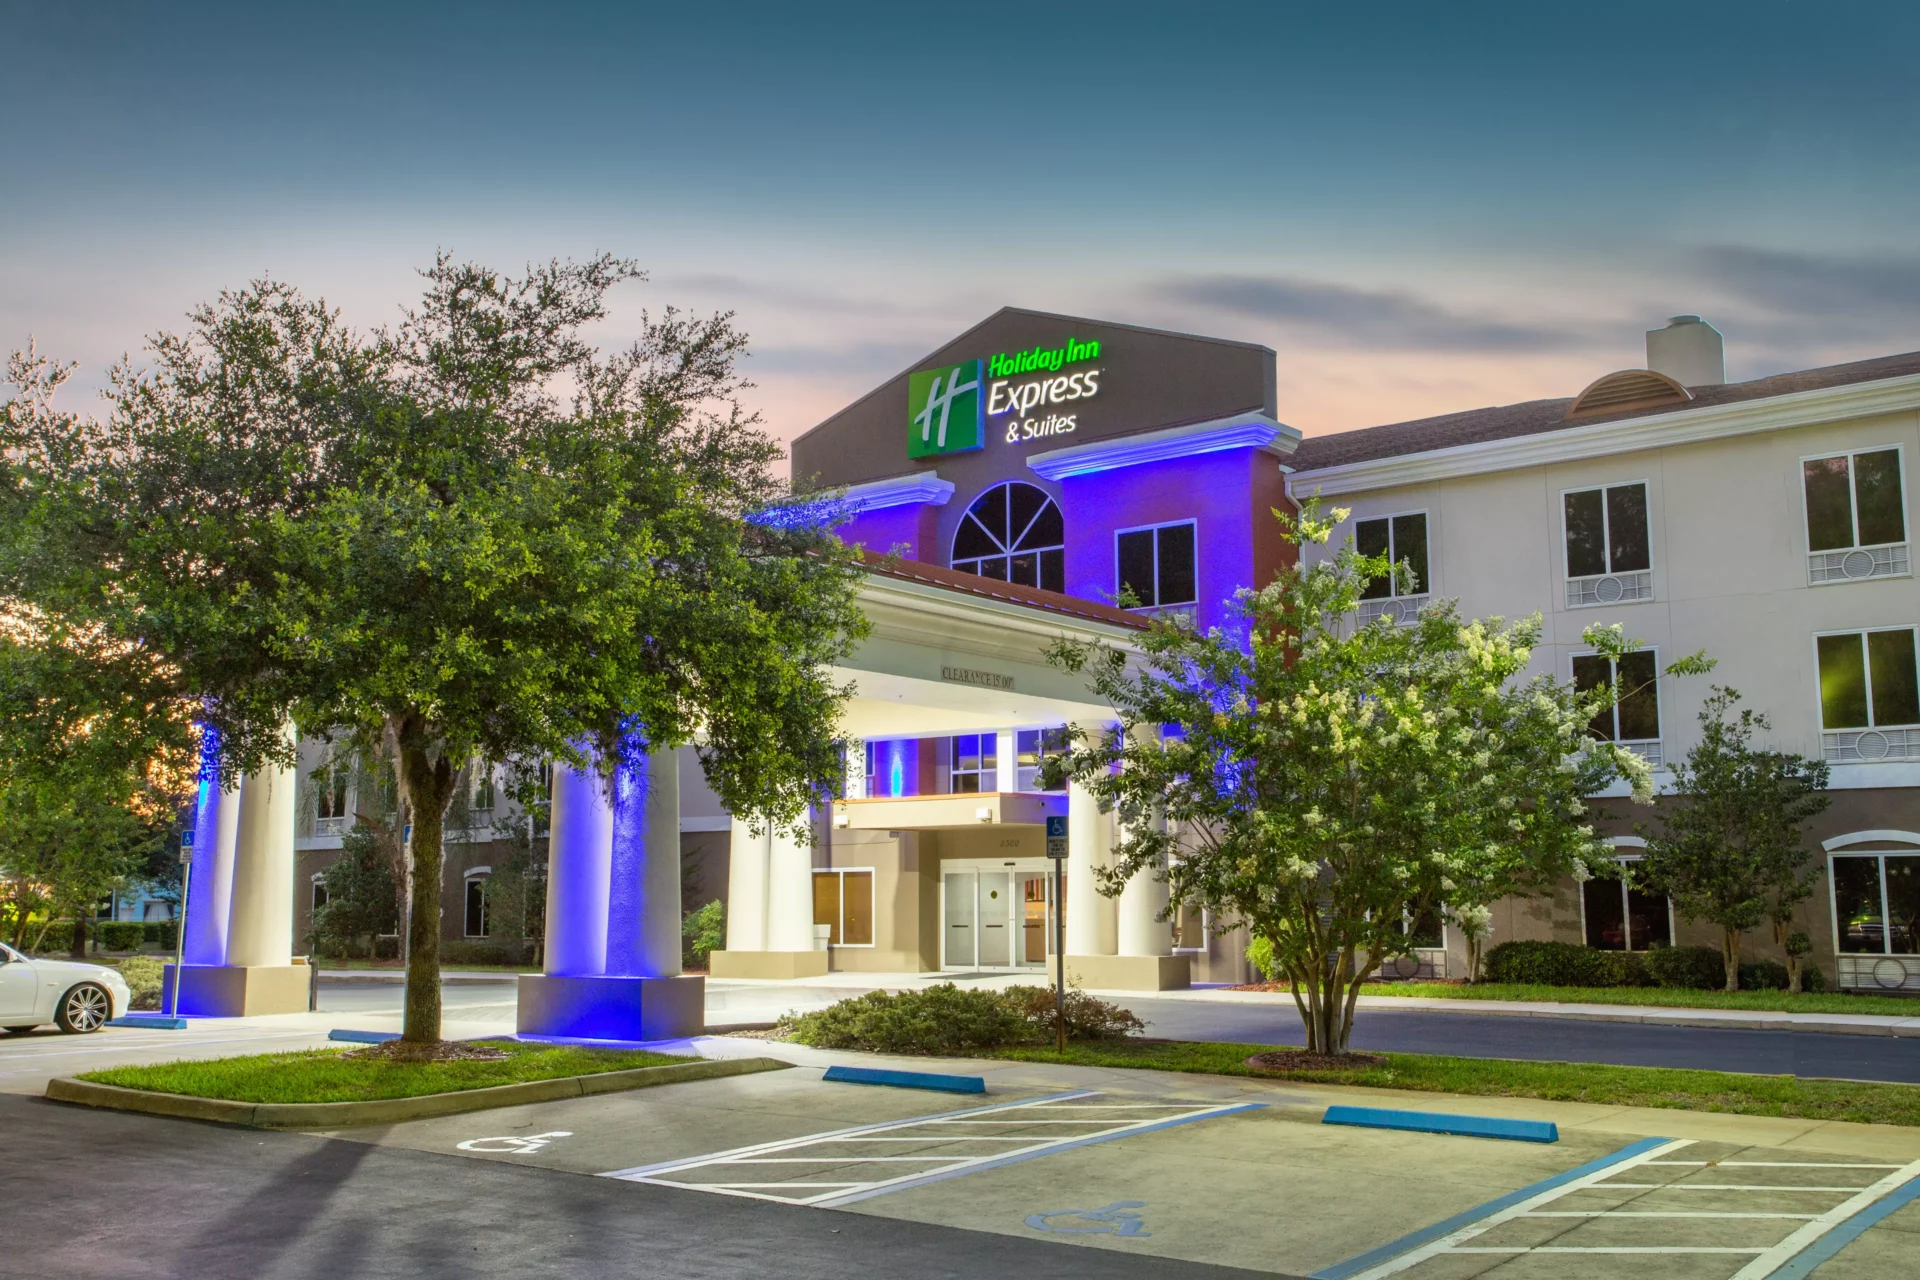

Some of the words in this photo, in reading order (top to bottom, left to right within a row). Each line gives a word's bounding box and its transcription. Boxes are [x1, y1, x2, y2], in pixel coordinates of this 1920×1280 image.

[988, 347, 1064, 377] Holiday
[1066, 338, 1099, 363] Inn
[987, 370, 1099, 418] Express
[1005, 421, 1020, 444] &
[1022, 414, 1077, 440] Suites
[942, 666, 992, 687] CLEARANCE
